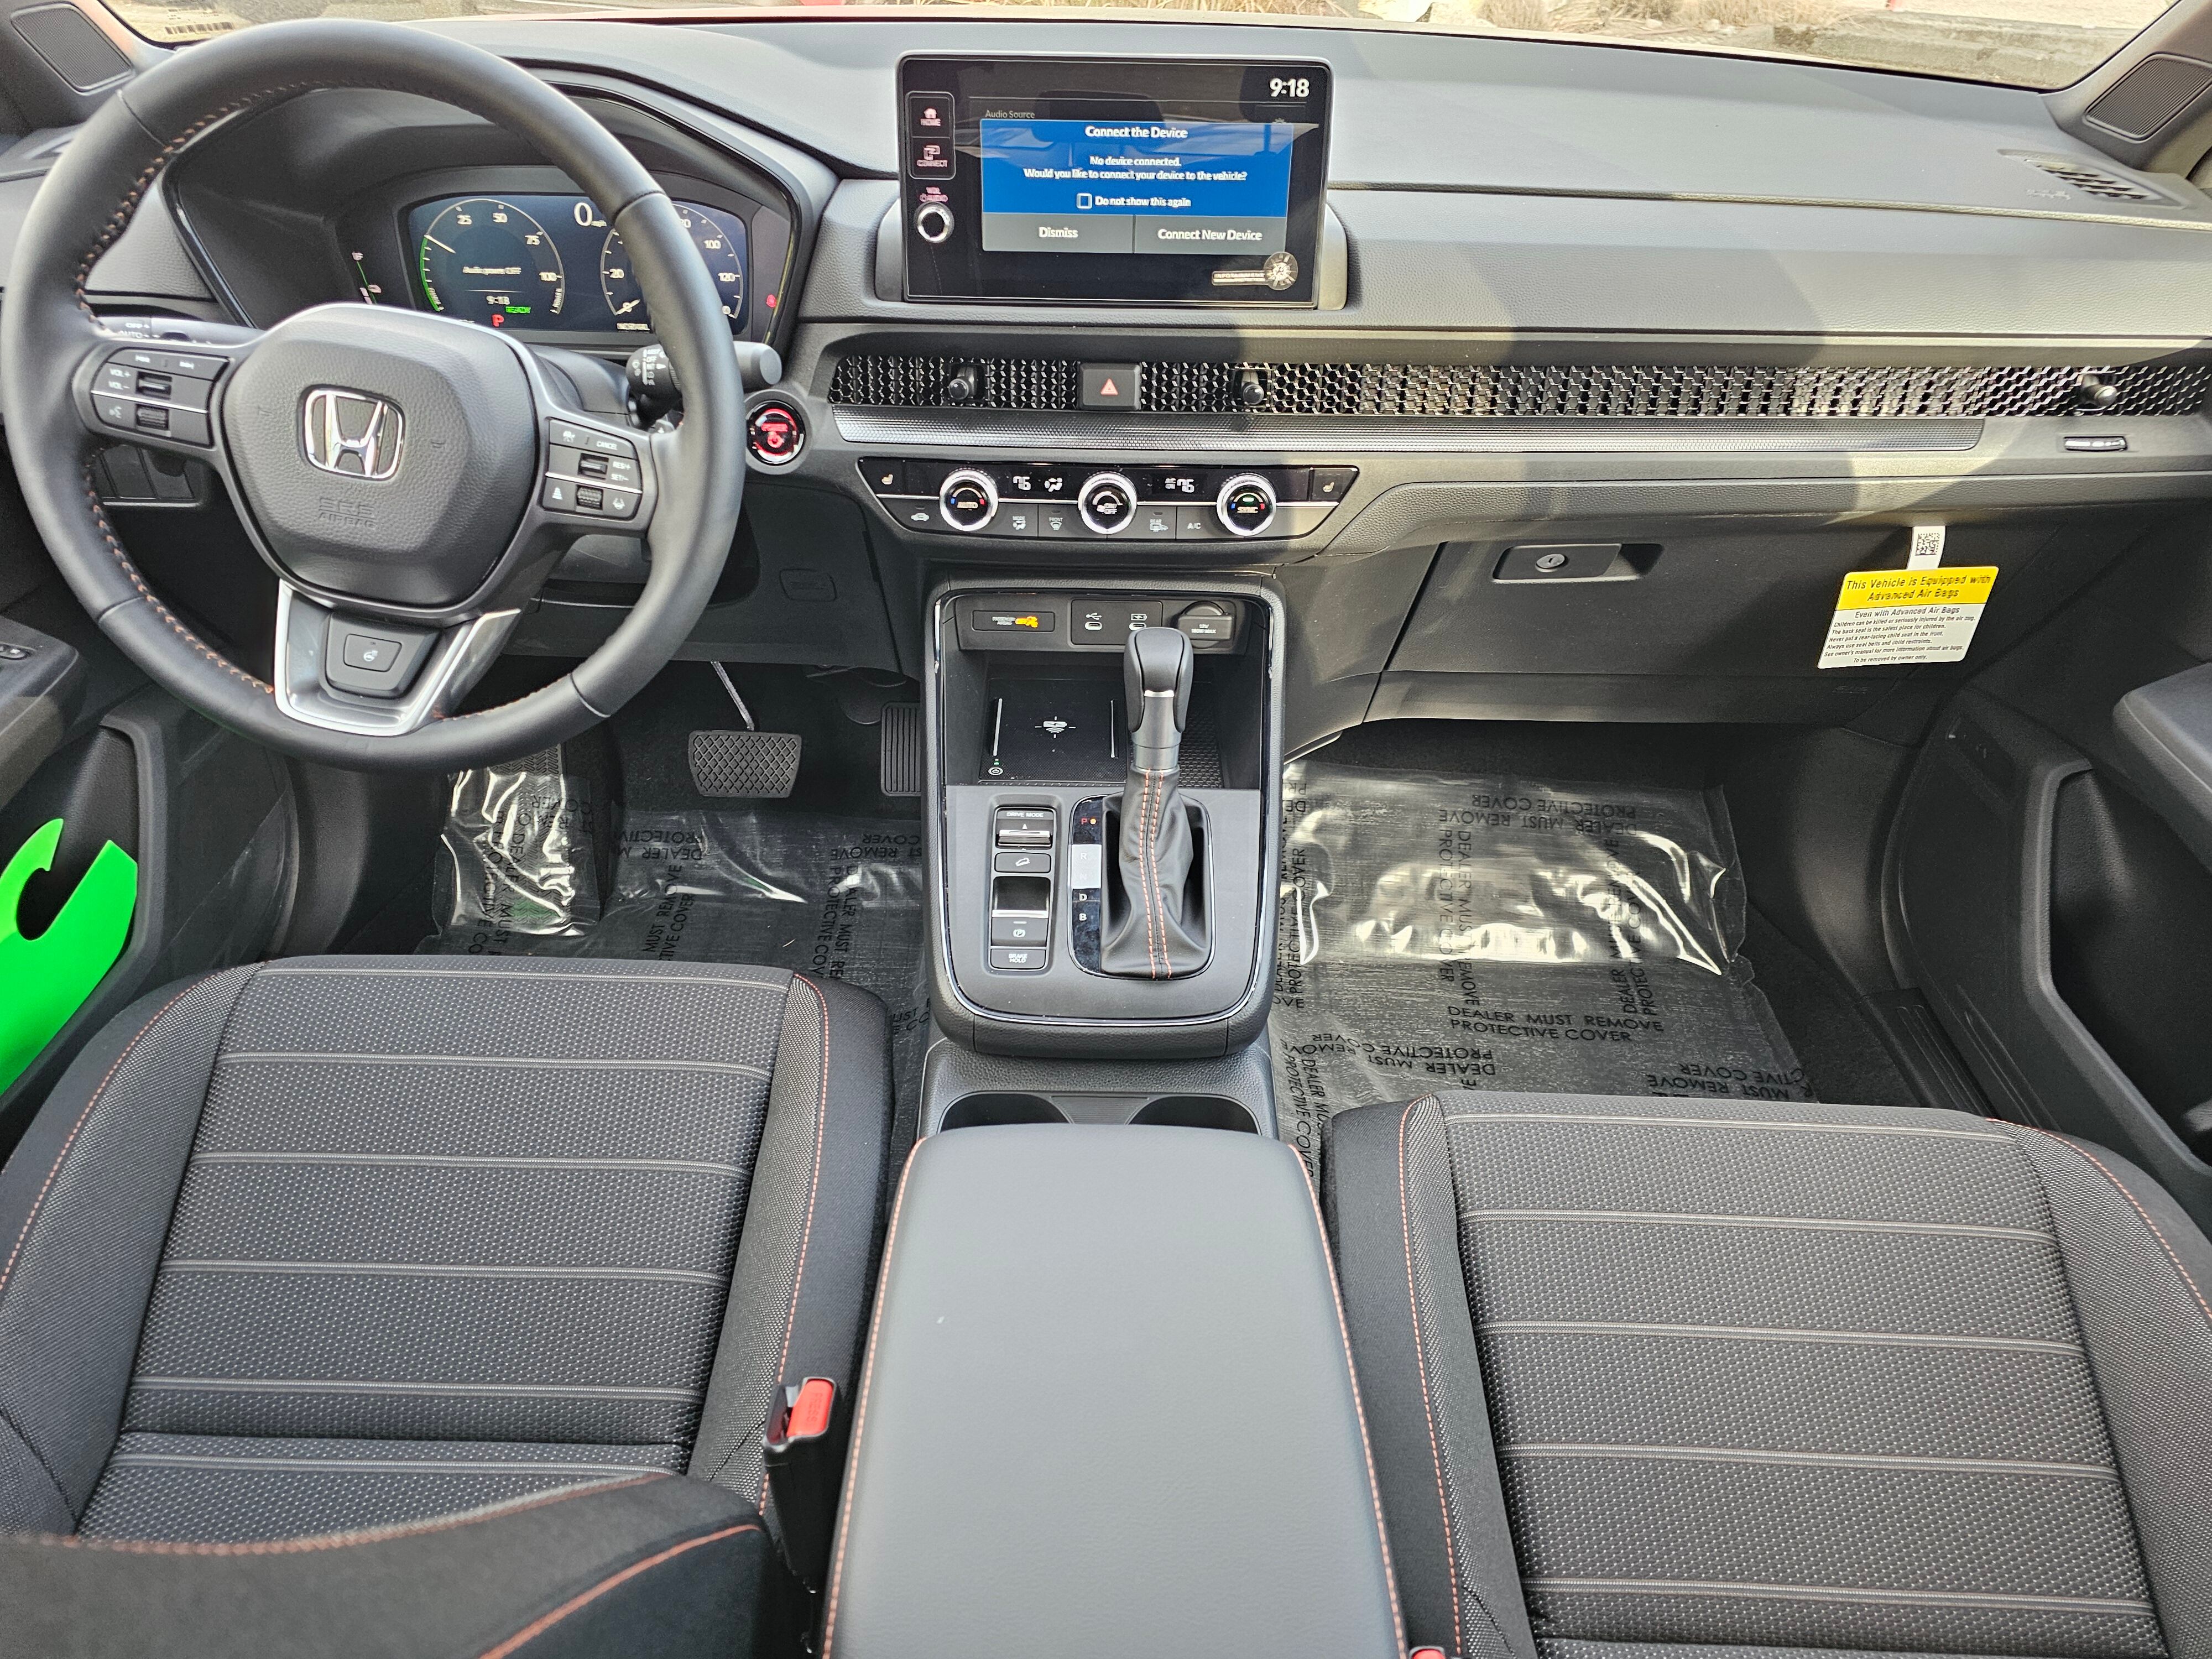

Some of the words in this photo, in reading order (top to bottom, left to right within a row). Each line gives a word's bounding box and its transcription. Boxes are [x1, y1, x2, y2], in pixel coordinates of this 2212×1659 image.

[1270, 79, 1310, 98] 9:18
[985, 109, 1008, 118] Audio
[1009, 110, 1035, 119] Source
[1084, 125, 1130, 138] Connect
[1131, 126, 1150, 138] the
[1150, 127, 1188, 138] Device
[1089, 155, 1104, 165] No
[1105, 156, 1134, 166] device
[1134, 157, 1182, 166] connected.
[1023, 168, 1054, 178] Would
[1054, 170, 1072, 180] you
[1072, 168, 1088, 178] like
[1088, 169, 1099, 179] to
[1099, 170, 1134, 179] connect
[1134, 171, 1156, 181] your
[1156, 170, 1185, 180] device
[1185, 171, 1196, 180] to
[1197, 171, 1213, 180] the
[1213, 171, 1248, 181] vehicle?
[1094, 196, 1109, 206] Do
[1109, 197, 1126, 206] not
[1126, 197, 1150, 206] show
[1150, 197, 1167, 207] this
[1167, 197, 1191, 208] again
[457, 215, 472, 225] 25
[493, 212, 508, 223] 50
[573, 202, 593, 227] 0
[524, 234, 540, 246] 75
[1038, 226, 1078, 239] Dismiss
[1157, 228, 1201, 240] Connect
[1201, 229, 1227, 241] New
[1227, 229, 1263, 241] Device
[703, 239, 722, 249] 100
[539, 272, 557, 281] 100
[609, 268, 625, 279] 20
[717, 272, 736, 281] 120
[492, 314, 504, 327] P
[1846, 580, 1866, 590] This
[1870, 578, 1905, 589] Vehicle
[1908, 576, 1917, 586] is
[1919, 575, 1967, 586] Equipped
[1969, 574, 1991, 584] with
[1867, 589, 1914, 602] Advanced
[1916, 589, 1933, 598] Air
[1935, 588, 1959, 598] Bags
[1890, 607, 1926, 615] Advanced
[1941, 606, 1960, 614] Bags
[1472, 794, 1532, 811] COVER
[1537, 798, 1636, 818] PROTECTIVE
[1439, 809, 1511, 827] REMOVE
[1522, 815, 1563, 831] MUST
[1575, 818, 1638, 836] DEALER
[862, 832, 920, 846] COVER
[642, 846, 703, 861] DEALER
[831, 846, 898, 860] REMOVE
[1458, 830, 1472, 889] DEALER
[1291, 847, 1307, 902] COVER
[1438, 829, 1453, 923] PROTECTIVE
[817, 866, 841, 941] PROTECTIVE
[1079, 893, 1088, 901] D
[641, 924, 665, 953] MUST
[656, 864, 683, 917] REMOVE
[670, 893, 696, 932] COVER
[1079, 913, 1088, 921] B
[833, 923, 853, 953] MUST
[1610, 968, 1639, 1015] DEALER
[1447, 1005, 1516, 1022] DEALER
[1525, 1013, 1573, 1026] MUST
[1584, 1015, 1665, 1032] REMOVE
[1451, 1018, 1560, 1040] PROTECTIVE
[1564, 1028, 1632, 1042] COVER
[1280, 1038, 1357, 1056] REMOVE
[1312, 1032, 1376, 1053] COVER
[1381, 1044, 1494, 1060] PROTECTIVE
[1368, 1054, 1412, 1069] MUST
[1425, 1061, 1496, 1076] DEALER
[1301, 1058, 1326, 1098] DEALER
[1679, 1062, 1747, 1081] COVER
[1281, 1051, 1312, 1119] PROTECTIVE
[1646, 1074, 1728, 1094] REMOVE
[1740, 1083, 1790, 1099] MUST
